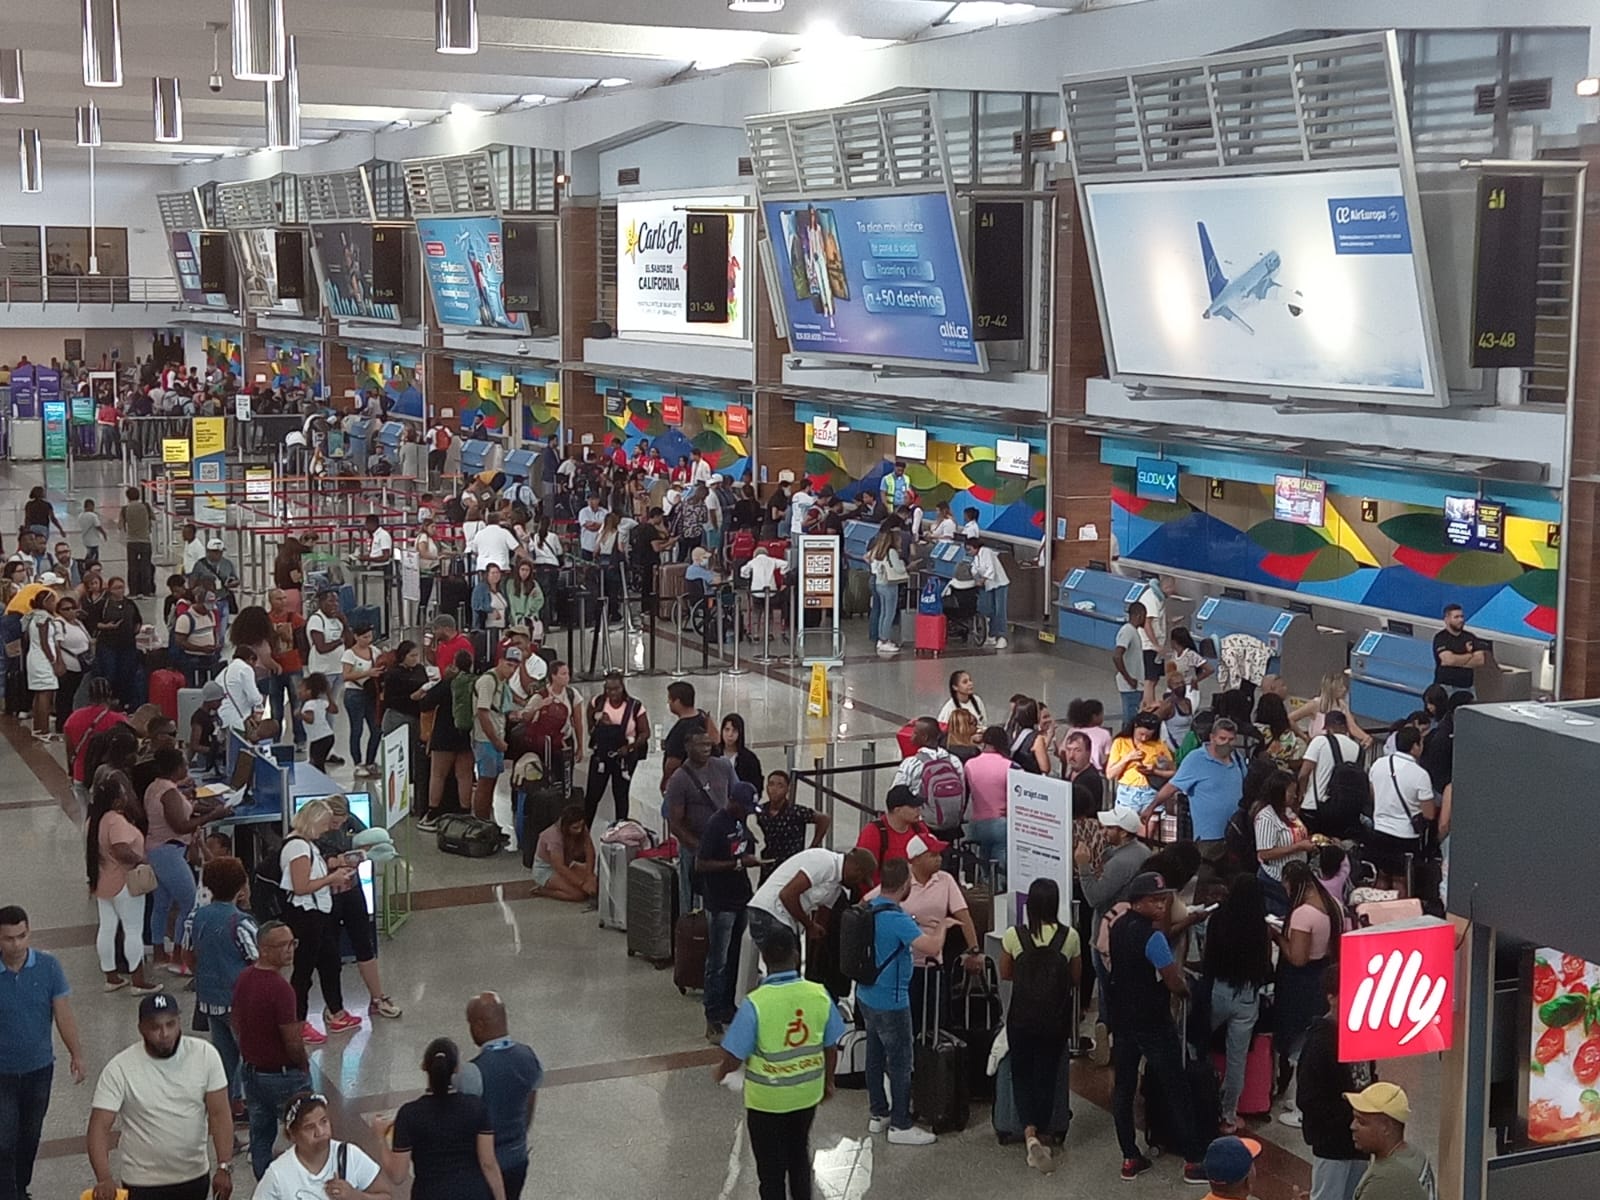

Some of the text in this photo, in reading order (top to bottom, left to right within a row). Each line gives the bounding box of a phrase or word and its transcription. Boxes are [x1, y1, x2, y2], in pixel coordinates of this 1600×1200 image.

[638, 220, 682, 254] Carl's Jr.
[638, 277, 680, 291] CALIFORNIA
[689, 302, 715, 312] 31-36
[876, 289, 896, 306] +50
[896, 289, 942, 308] destinos
[977, 315, 1008, 327] 37-42
[939, 321, 969, 339] altice
[1478, 332, 1516, 348] 43-48
[1347, 949, 1447, 1045] illy
